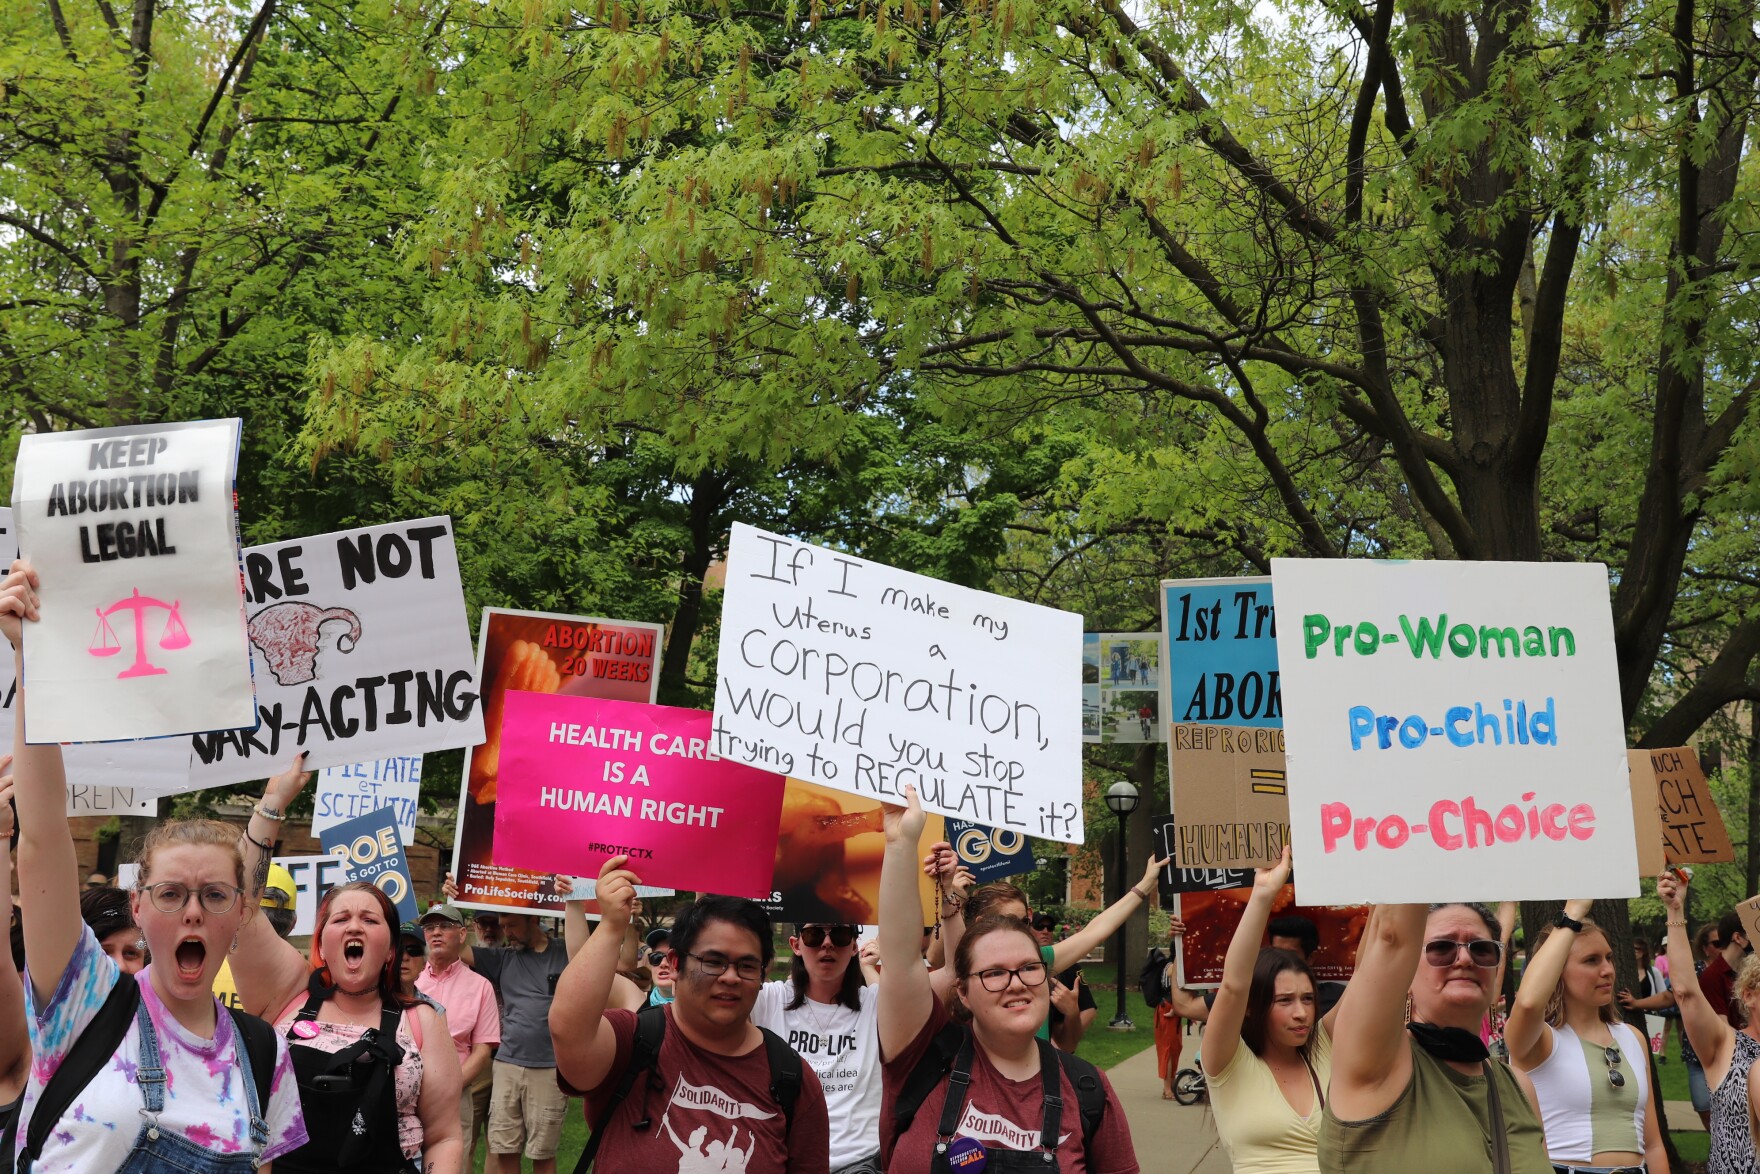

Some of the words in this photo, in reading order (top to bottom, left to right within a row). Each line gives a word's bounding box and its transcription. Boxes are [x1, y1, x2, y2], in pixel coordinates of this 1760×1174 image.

[88, 437, 168, 471] KEEP
[47, 470, 200, 517] ABORTION
[79, 518, 176, 563] LEGAL
[245, 545, 309, 604] RE
[337, 525, 447, 590] NOT
[750, 535, 813, 586] If
[828, 557, 863, 598] I
[881, 587, 950, 619] make
[973, 613, 1009, 641] my
[1176, 592, 1222, 641] 1st
[543, 624, 654, 658] ABORTION
[929, 644, 947, 660] a
[1303, 613, 1576, 660] Pro-Woman
[563, 656, 587, 677] 20
[593, 658, 650, 683] WEEKS
[549, 722, 643, 752] HEALTH
[649, 733, 720, 762] CARE
[1348, 696, 1558, 751] Pro-Child
[602, 761, 626, 783] IS
[630, 765, 650, 786] A
[713, 714, 794, 775] trying
[806, 743, 838, 780] to
[855, 753, 1027, 827] REGULATE
[1039, 801, 1078, 839] it?
[889, 733, 949, 773] you
[962, 743, 1025, 792] stop
[540, 786, 633, 818] HUMAN
[640, 799, 725, 828] RIGHT
[1319, 791, 1597, 855] Pro-Choice
[329, 825, 399, 871] ROE
[588, 842, 653, 859] #PROTECTX
[956, 827, 1024, 864] GO
[359, 862, 382, 878] GOT
[383, 857, 399, 867] TO
[837, 1068, 858, 1078] idea
[838, 1083, 854, 1091] are
[680, 1086, 742, 1115] SOLIDARITY
[966, 1115, 1035, 1148] SOLIDARITY
[968, 1151, 985, 1166] ALL
